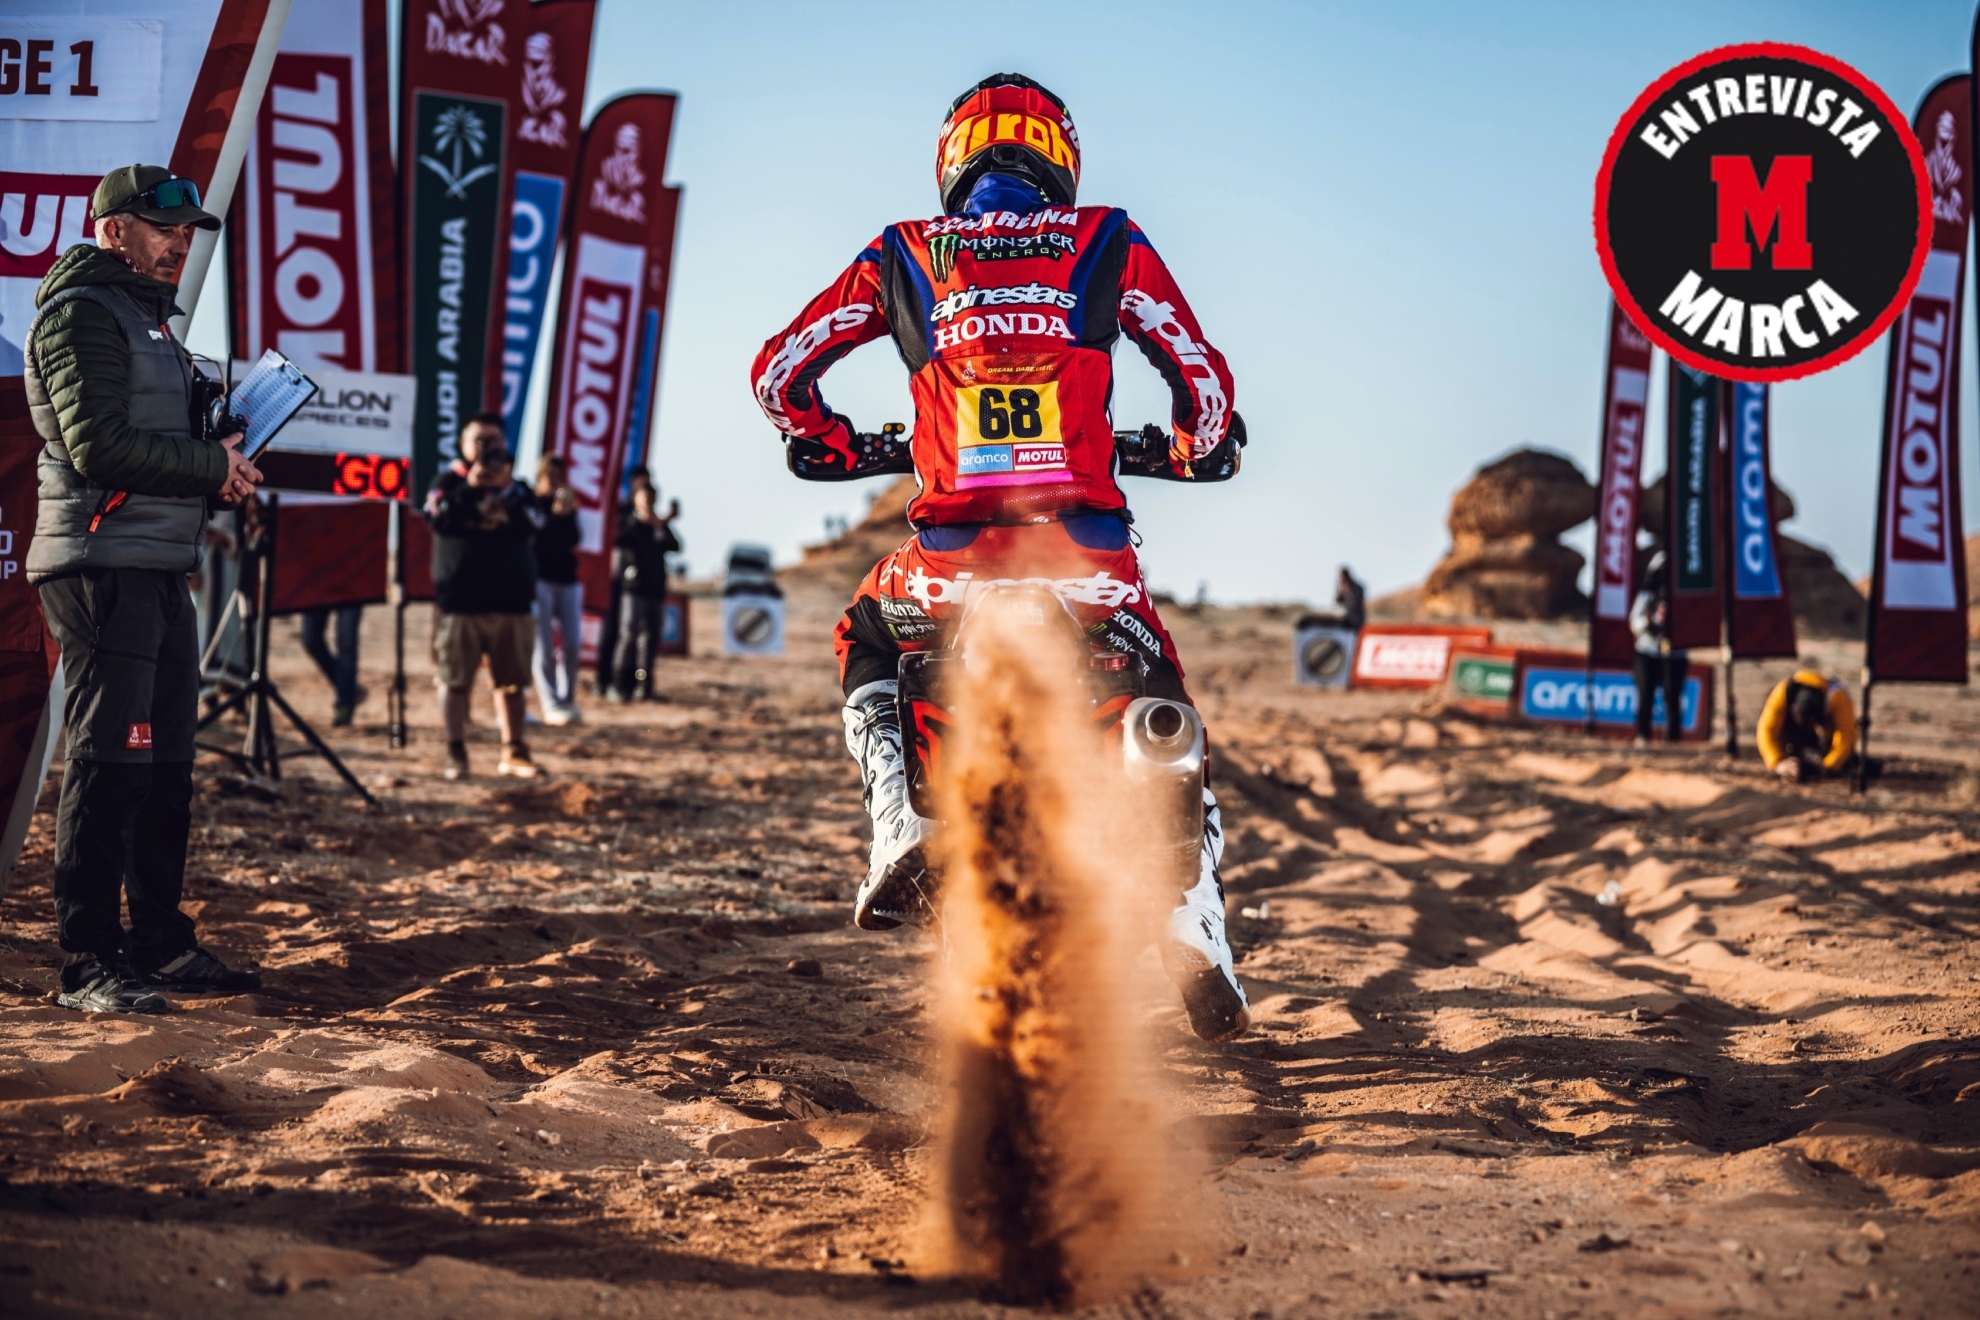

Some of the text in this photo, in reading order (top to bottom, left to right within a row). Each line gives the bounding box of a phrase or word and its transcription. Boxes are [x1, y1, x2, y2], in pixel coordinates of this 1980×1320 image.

[70, 40, 99, 96] 1
[959, 232, 1076, 253] MONSTER
[977, 247, 1061, 259] ENERGY
[437, 217, 467, 362] ARABIA
[930, 282, 1078, 322] alpinestars
[934, 313, 1076, 351] HONDA
[567, 294, 622, 499] MOTUL
[979, 388, 1043, 440] 68
[1899, 310, 1946, 551] MOTUL
[341, 456, 401, 494] GO
[960, 453, 1009, 466] aramco
[1017, 449, 1064, 464] MOTUL
[1606, 413, 1639, 575] MOTUL
[880, 597, 928, 617] HONDA
[1110, 609, 1161, 658] HONDA
[1532, 680, 1690, 713] aram
